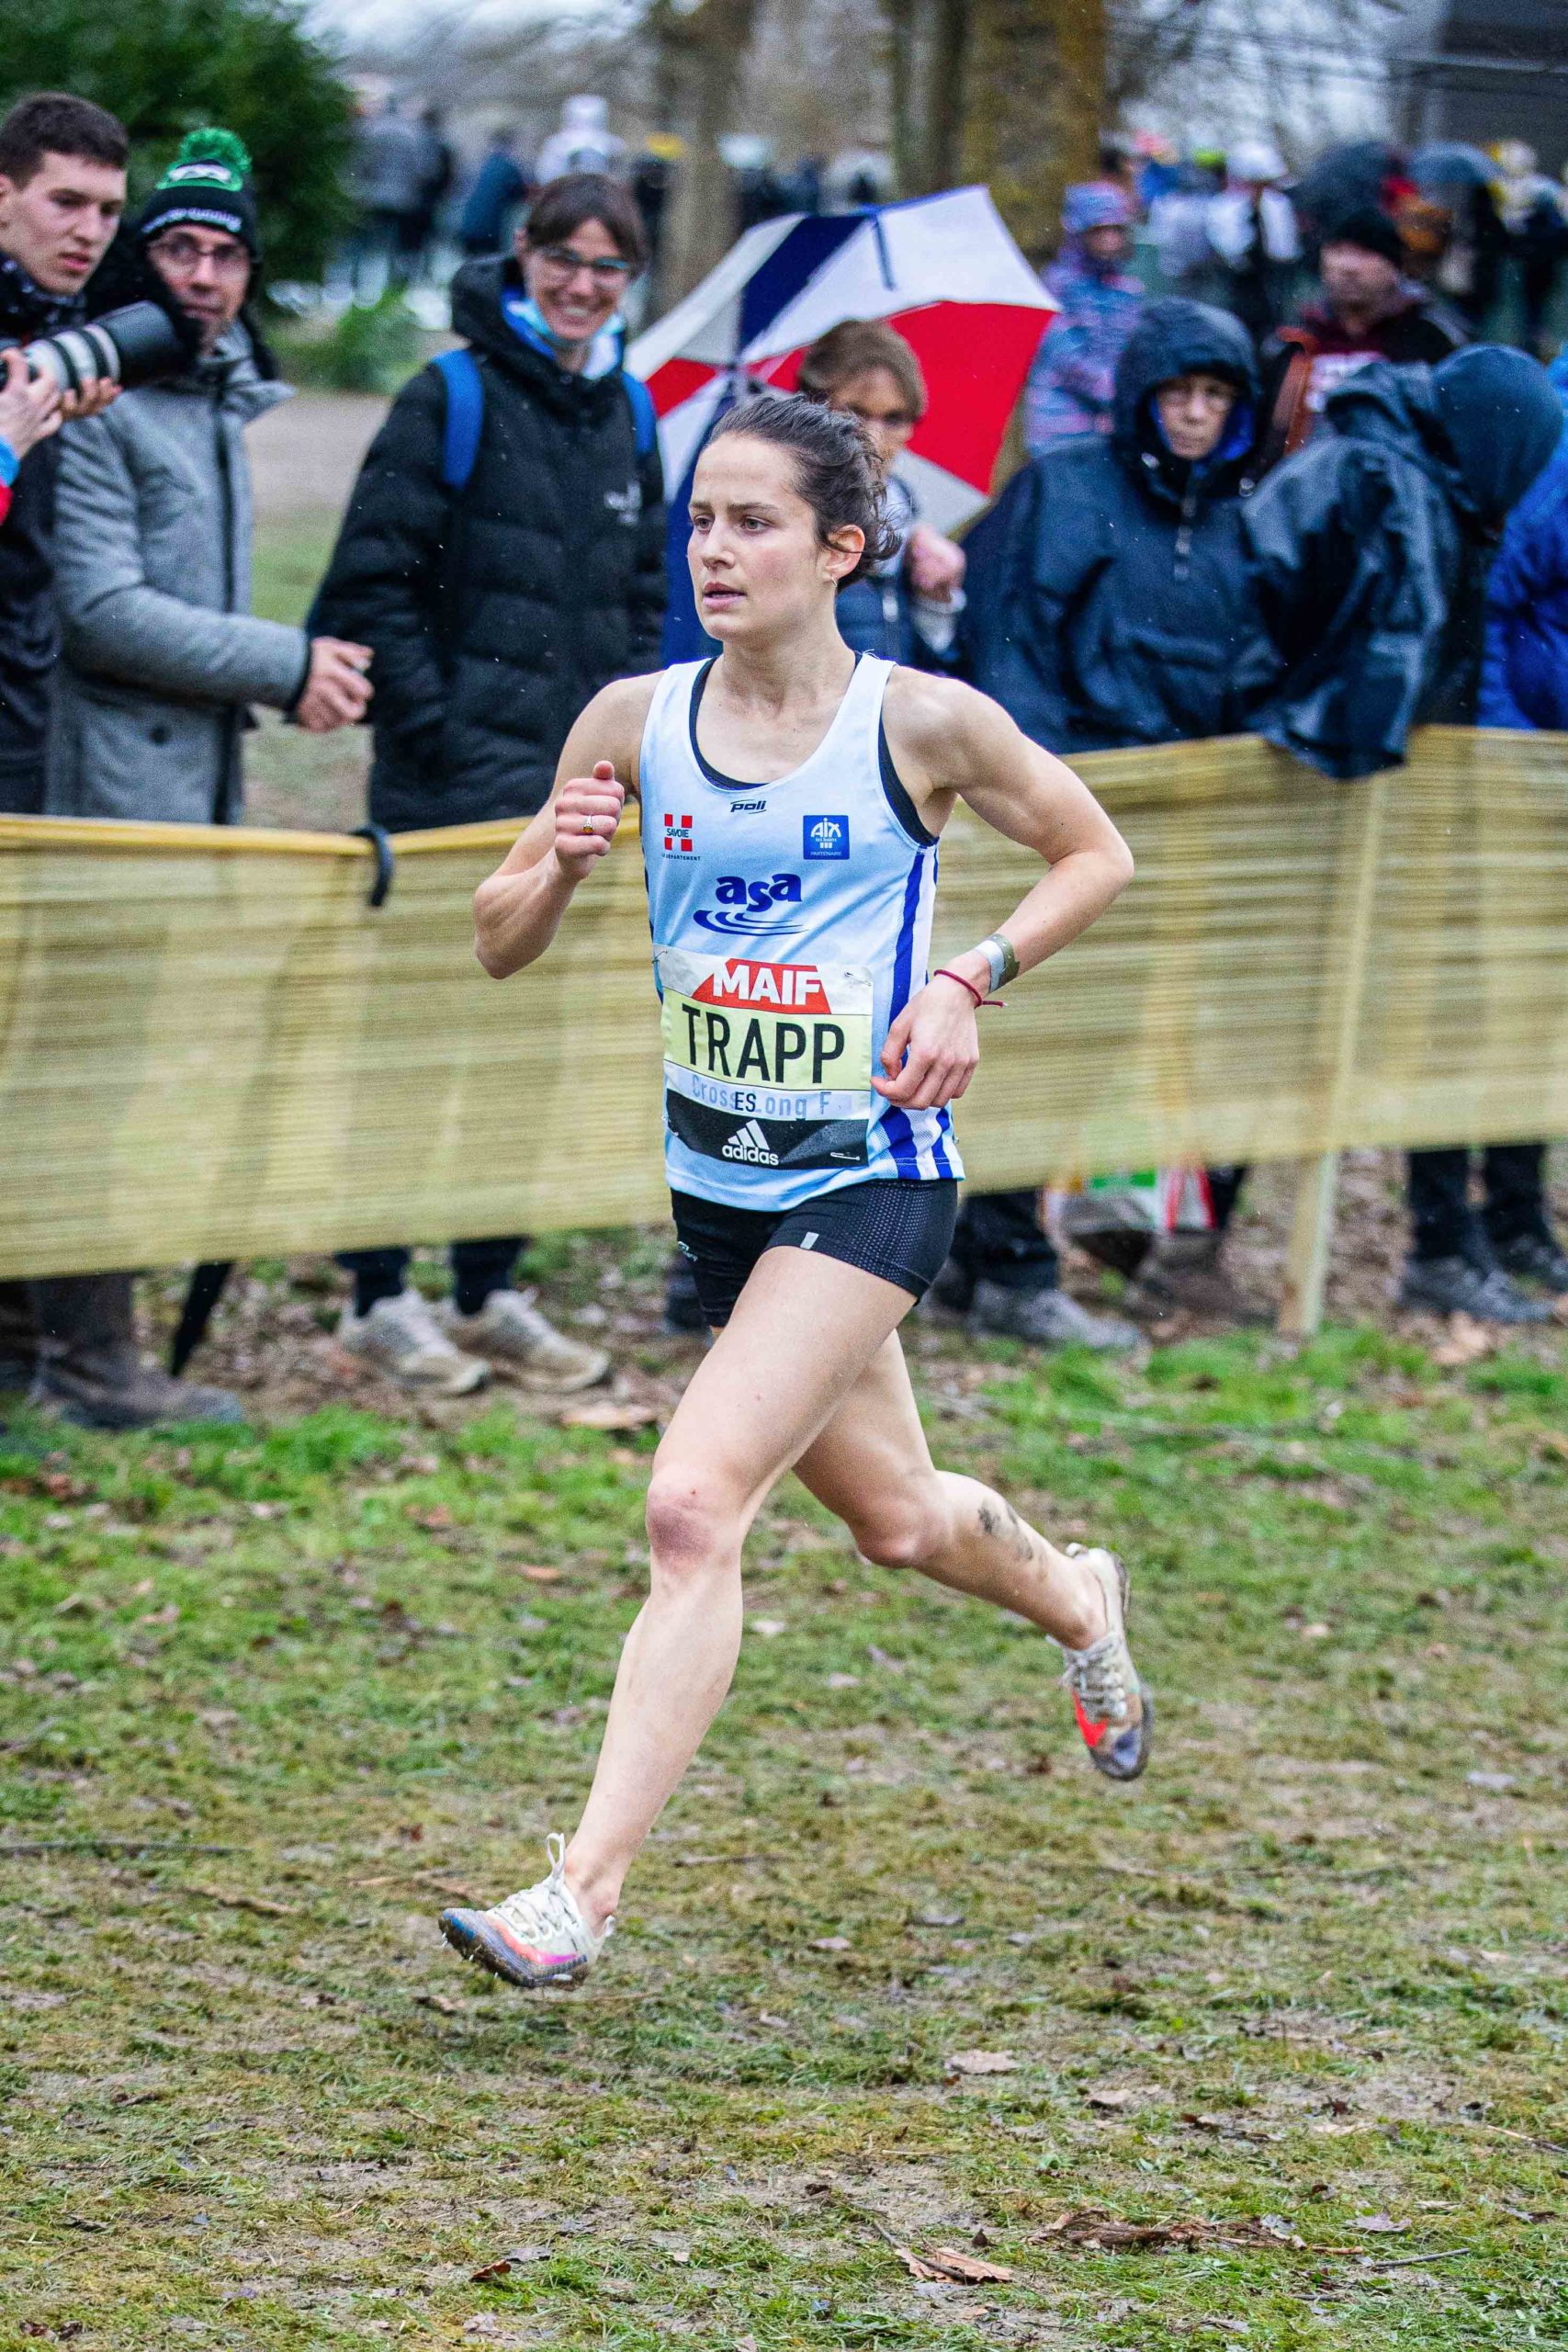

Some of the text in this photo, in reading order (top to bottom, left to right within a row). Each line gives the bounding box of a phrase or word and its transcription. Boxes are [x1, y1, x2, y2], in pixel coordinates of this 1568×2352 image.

[730, 800, 767, 812] poli
[667, 828, 689, 838] SAVOIE
[716, 874, 803, 912] asa
[713, 964, 821, 1006] MAIF
[682, 1003, 845, 1084] TRAPP
[735, 1091, 757, 1113] ES
[722, 1144, 779, 1166] adidas
